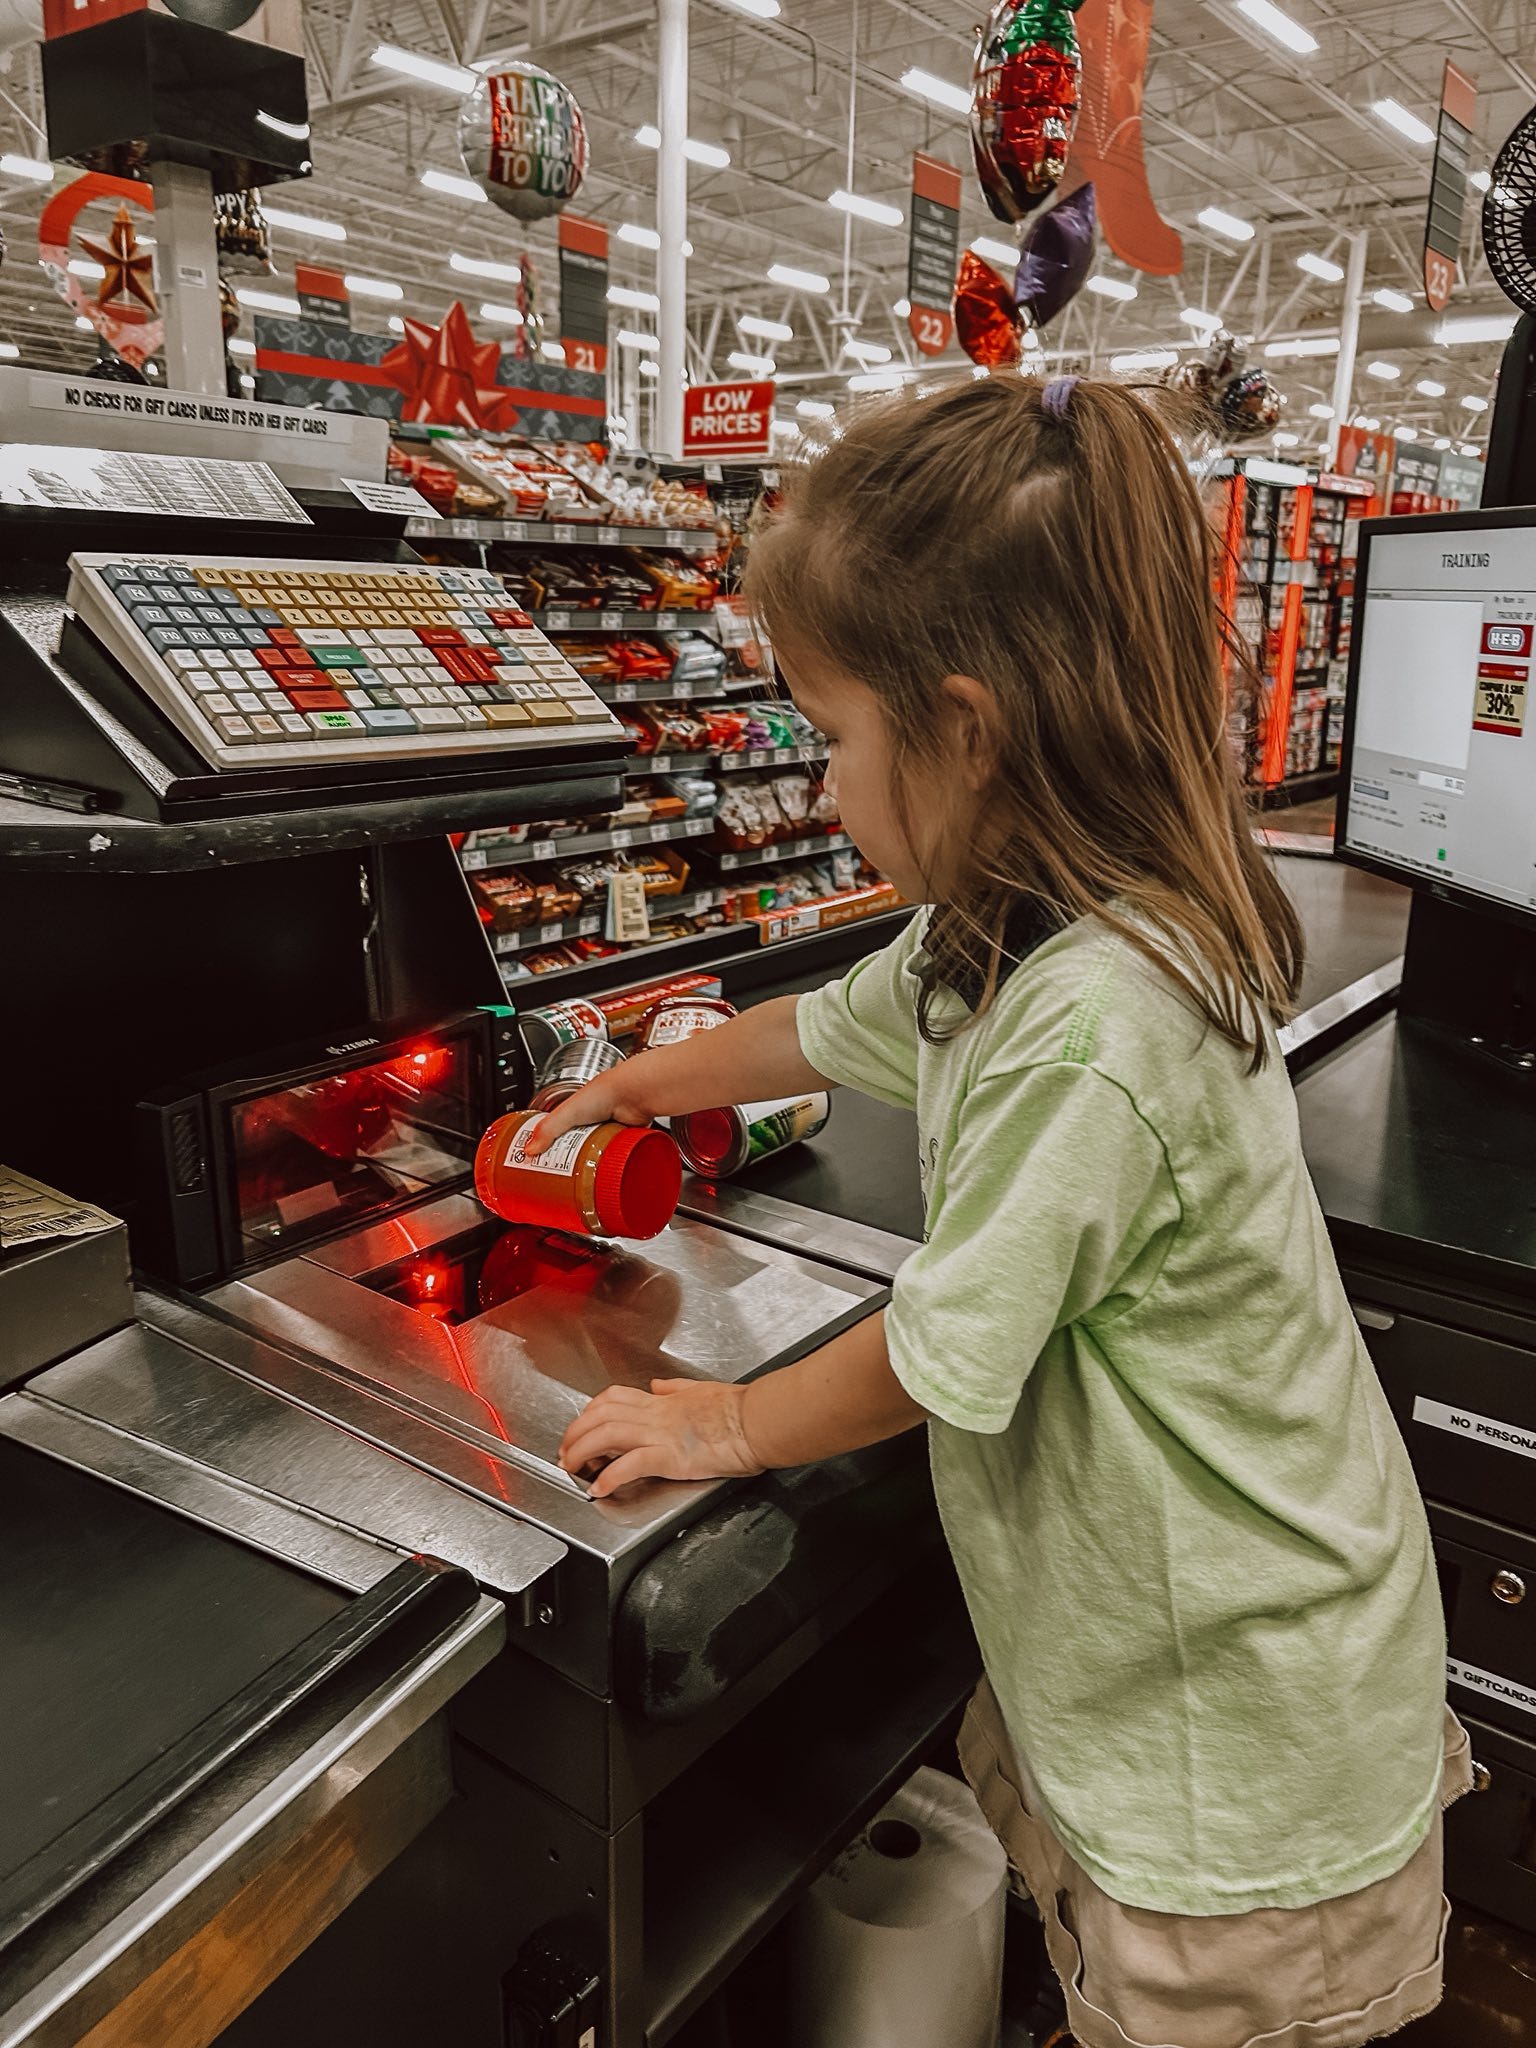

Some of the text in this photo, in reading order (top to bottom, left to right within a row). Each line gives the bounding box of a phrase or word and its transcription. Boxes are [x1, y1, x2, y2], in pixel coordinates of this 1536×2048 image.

[498, 151, 580, 194] TO YOU
[214, 193, 246, 216] PPY
[1429, 261, 1449, 299] 23
[919, 315, 944, 347] 22
[574, 347, 596, 373] 21
[65, 388, 80, 405] NO
[83, 390, 121, 410] CHECKS
[123, 395, 143, 412] FOR
[145, 398, 165, 415] GIFT
[167, 401, 197, 419] CARDS
[199, 404, 229, 423] UNLESS
[248, 411, 264, 428] FOR
[284, 416, 300, 432] GIFT
[302, 418, 328, 435] CARDS
[703, 389, 753, 413] LOW
[691, 412, 762, 437] PRICES
[1441, 552, 1490, 568] TRAINING
[160, 631, 239, 641] F10 F11 F12
[1485, 692, 1515, 716] 30%
[342, 1038, 380, 1051] ZEBRA
[1451, 1415, 1536, 1451] NO PERSONA
[1464, 1671, 1536, 1707] GIFTCARDS
